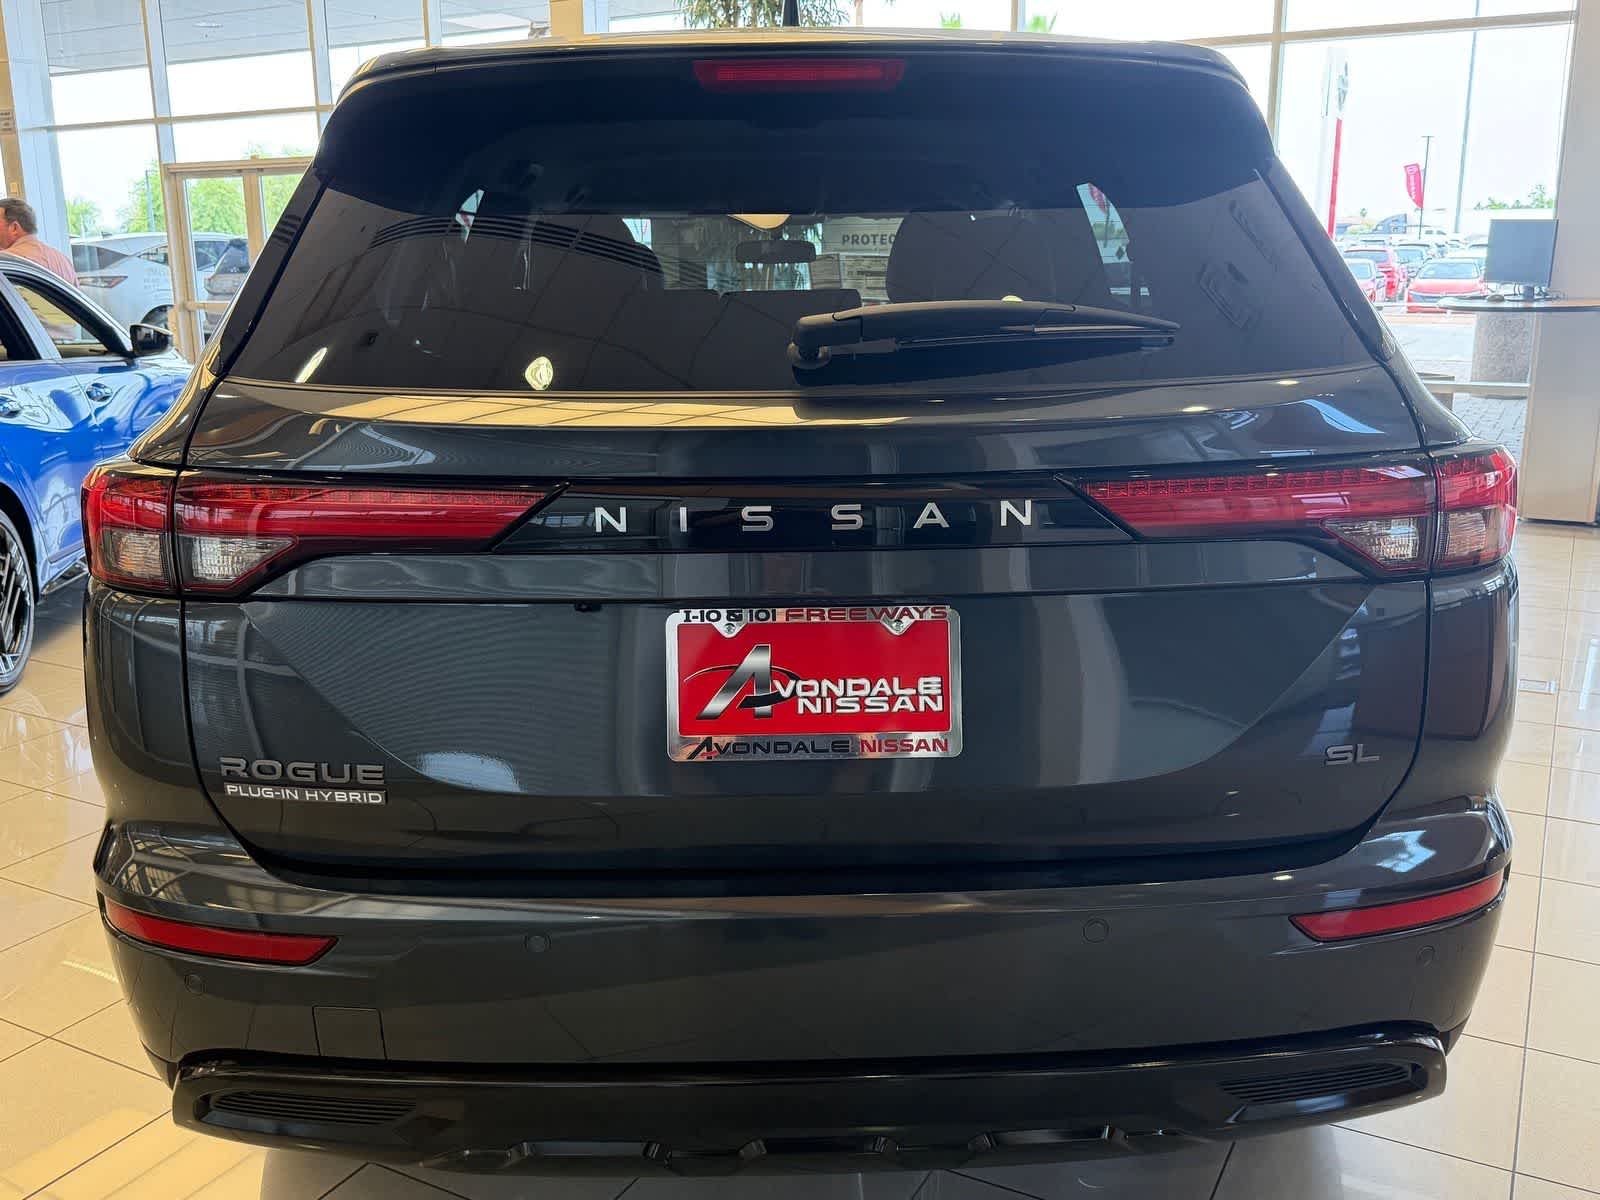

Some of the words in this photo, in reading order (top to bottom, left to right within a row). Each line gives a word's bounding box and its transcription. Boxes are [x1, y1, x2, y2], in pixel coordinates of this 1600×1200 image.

[594, 499, 1033, 533] NISSAN
[683, 609, 722, 623] I-10
[726, 609, 743, 622] &
[749, 608, 777, 622] 101
[785, 606, 948, 622] FREEWAYS
[696, 643, 943, 721] AVONDALE
[797, 695, 944, 715] NISSAN
[687, 736, 850, 760] AVONDALE
[860, 738, 949, 753] NISSAN
[1325, 743, 1381, 766] SL
[219, 756, 385, 785] ROGUE
[226, 784, 300, 800] PLUG-IN
[305, 790, 383, 804] HYBRID
